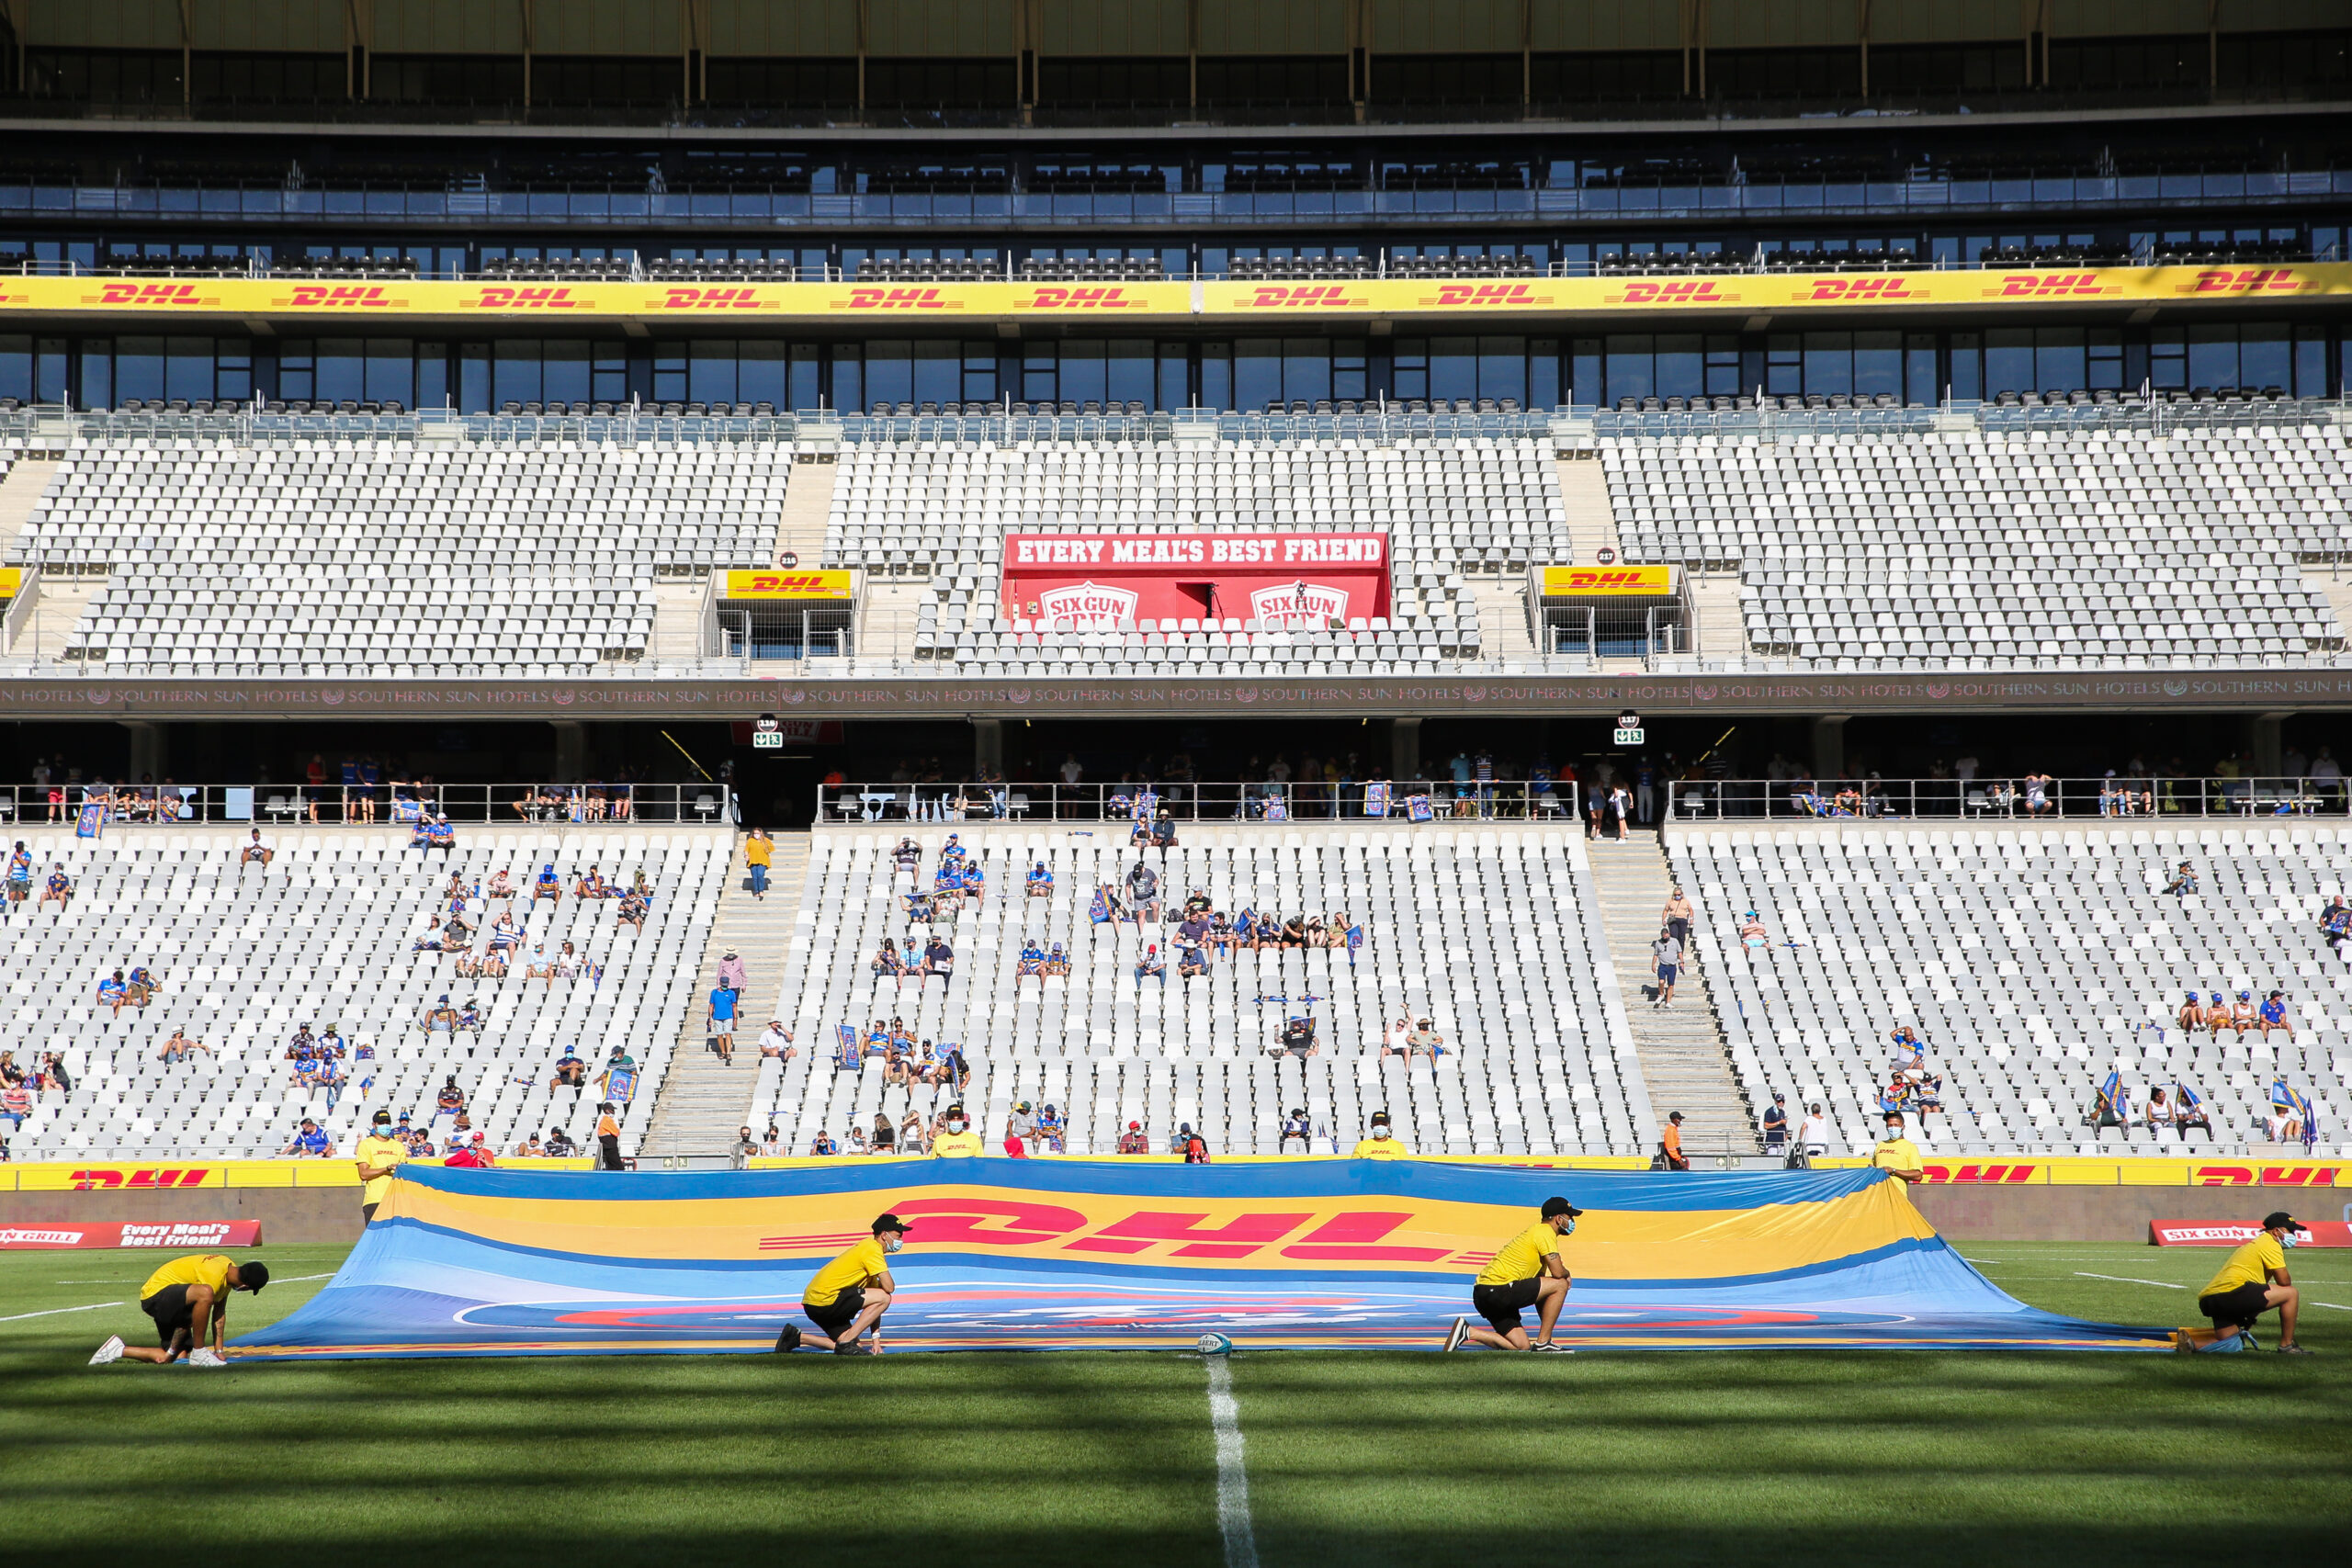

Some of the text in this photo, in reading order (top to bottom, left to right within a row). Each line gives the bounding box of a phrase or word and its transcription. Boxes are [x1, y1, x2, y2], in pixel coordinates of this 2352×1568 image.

[102, 285, 1128, 308] DHL DHL DHL DHL DHL DHL
[1254, 271, 2299, 306] DHL DHL DHL DHL DHL DHL
[1017, 538, 1380, 562] EVERY MEAL'S BEST FRIEND
[750, 577, 826, 592] DHL
[1569, 572, 1645, 589] DHL
[1050, 596, 1126, 615] SIX GUN
[1261, 596, 1292, 615] SIX
[21, 690, 85, 702] HOTELS
[114, 690, 209, 702] SOUTHERN
[213, 690, 251, 702] SUN
[255, 690, 319, 702] HOTELS
[348, 690, 441, 702] SOUTHERN
[445, 690, 481, 702] SUN
[487, 690, 550, 702] HOTELS
[579, 690, 670, 702] SOUTHERN
[675, 690, 710, 702] SUN
[715, 690, 778, 702] HOTELS
[808, 690, 899, 702] SOUTHERN
[904, 690, 940, 702] SUN
[944, 690, 1007, 702] HOTELS
[1035, 689, 1125, 701] SOUTHERN
[1129, 689, 1166, 701] SUN
[1171, 688, 1233, 700] HOTELS
[1261, 688, 1353, 700] SOUTHERN
[1358, 688, 1393, 700] SUN
[1397, 687, 1461, 699] HOTELS
[1489, 687, 1582, 699] SOUTHERN
[1586, 687, 1623, 699] SUN
[1627, 686, 1690, 698] HOTELS
[1721, 685, 1814, 697] SOUTHERN
[1818, 685, 1856, 697] SUN
[1860, 684, 1924, 696] HOTELS
[1952, 683, 2048, 695] SOUTHERN
[2052, 682, 2090, 694] SUN
[2095, 682, 2160, 694] HOTELS
[2191, 682, 2289, 694] SOUTHERN
[2292, 681, 2331, 693] SUN
[22, 1233, 74, 1242] GRILL
[120, 1223, 231, 1235] Every Meal's
[886, 1199, 1453, 1262] DHL
[2168, 1230, 2199, 1239] SIX
[2204, 1229, 2245, 1238] GUN
[120, 1234, 222, 1247] Best Friend
